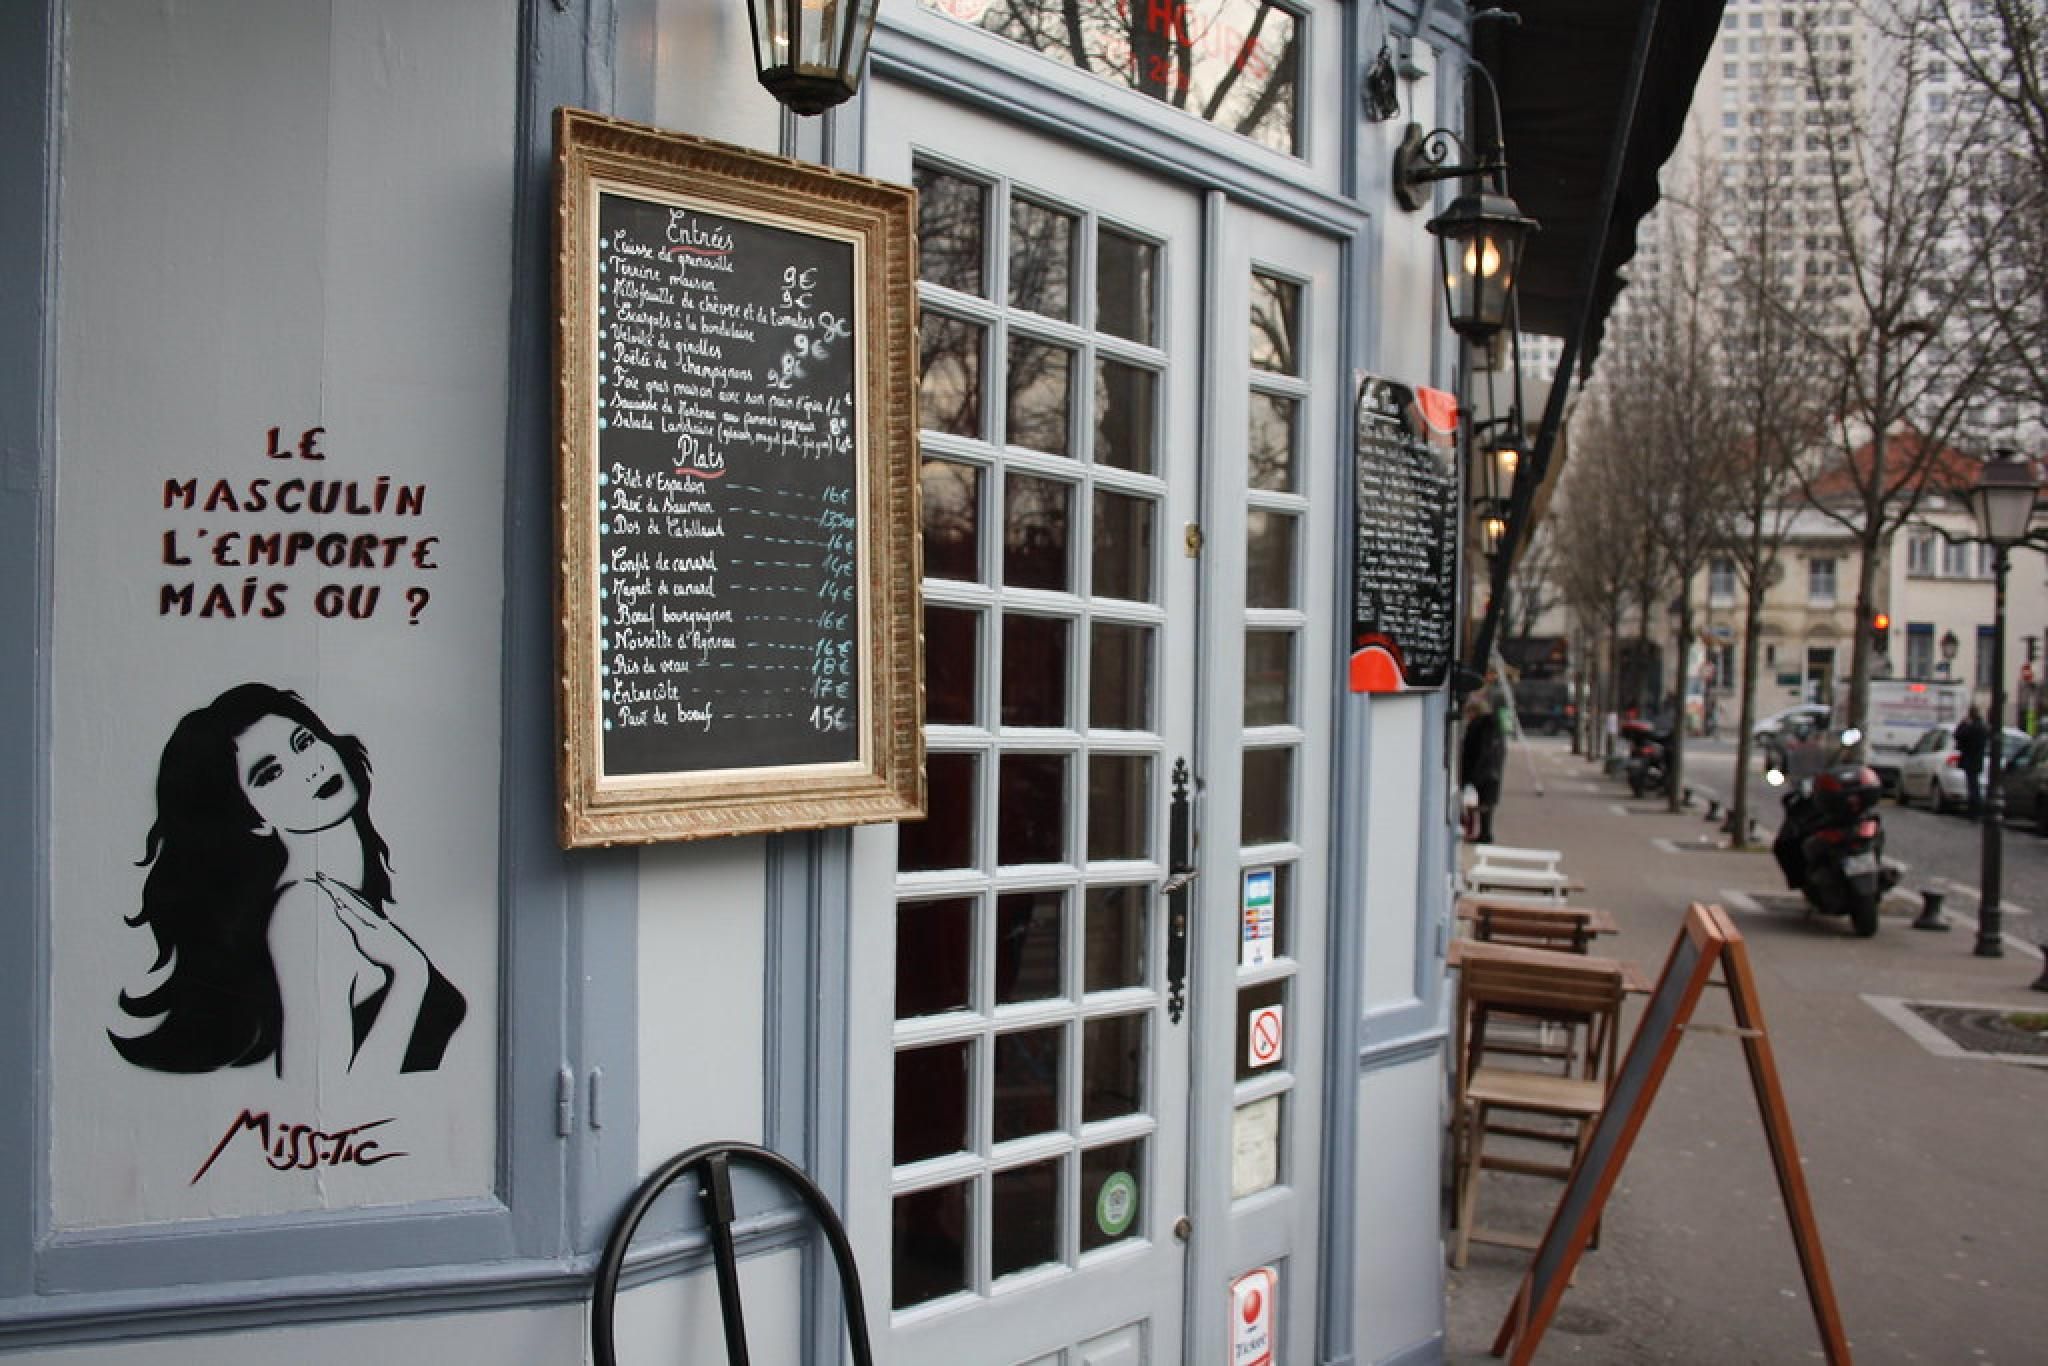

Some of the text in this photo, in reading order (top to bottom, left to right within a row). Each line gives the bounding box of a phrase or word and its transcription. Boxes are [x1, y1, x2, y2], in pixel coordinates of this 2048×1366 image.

[657, 245, 672, 263] de
[609, 255, 660, 281] Terrine
[681, 291, 695, 309] de
[265, 425, 327, 461] LE
[671, 432, 726, 469] Plats
[645, 497, 660, 514] de
[646, 516, 661, 536] de
[161, 528, 441, 569] L'EMPORTE
[655, 550, 671, 571] de
[656, 578, 670, 597] de
[313, 583, 382, 620] OU
[404, 585, 432, 627] ?
[652, 703, 670, 726] de
